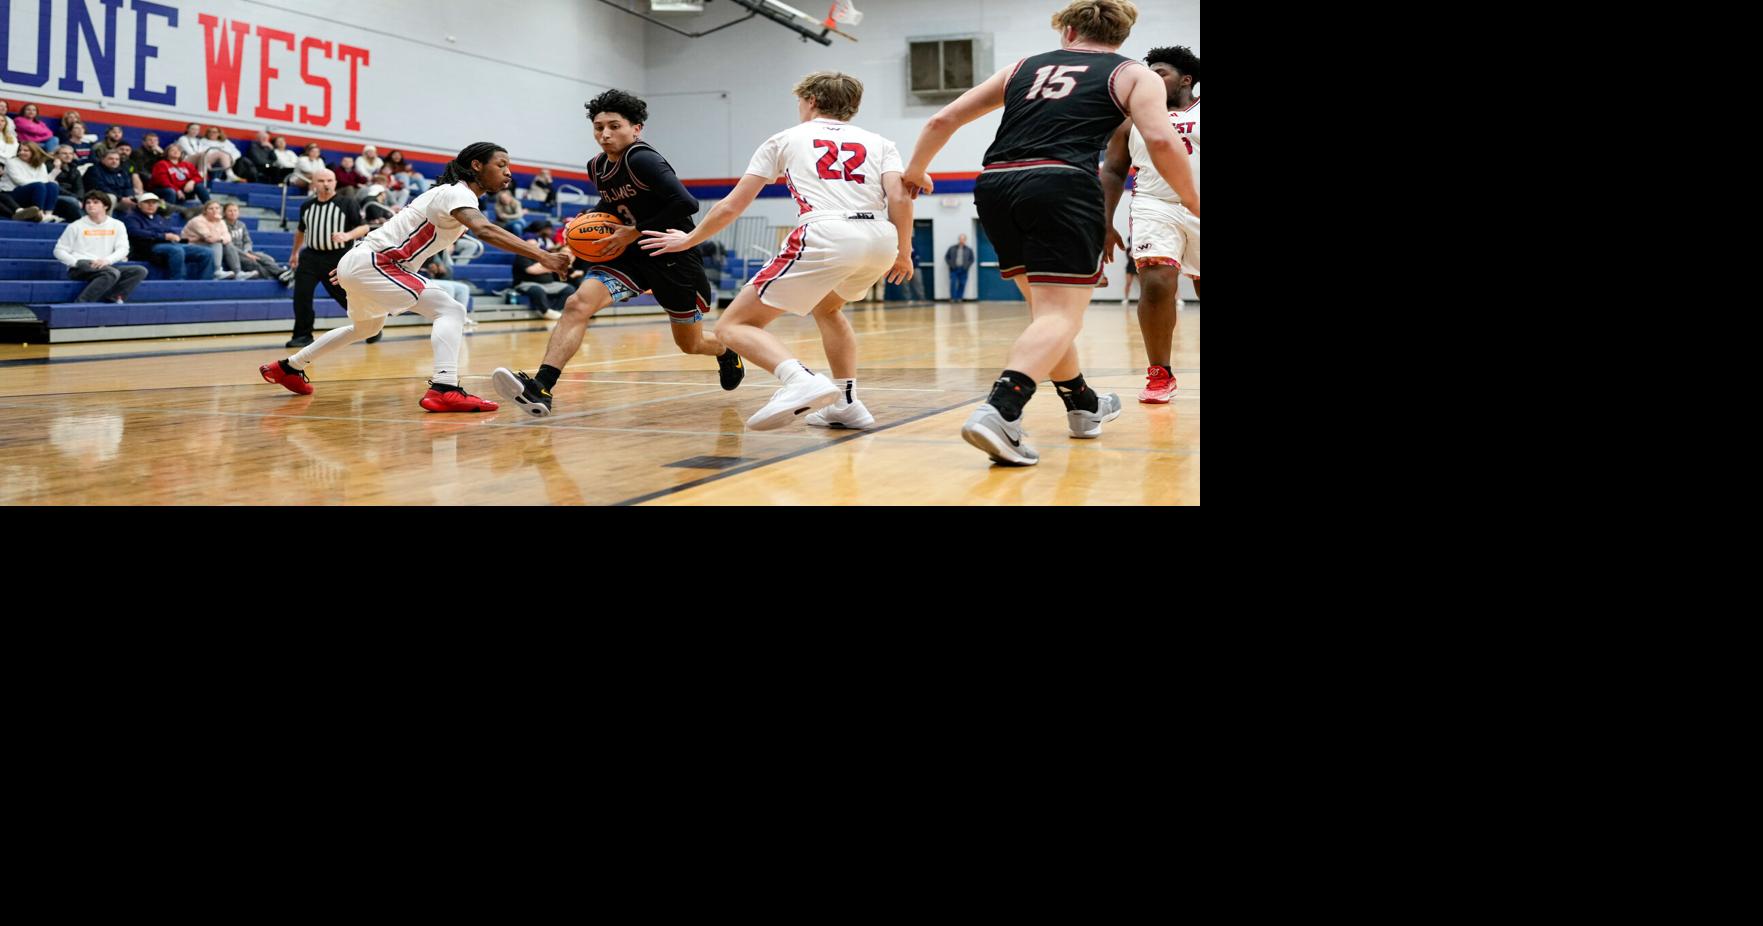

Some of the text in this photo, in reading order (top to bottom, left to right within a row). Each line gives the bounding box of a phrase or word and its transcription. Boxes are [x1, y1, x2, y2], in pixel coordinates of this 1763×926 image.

[198, 12, 370, 131] WEST
[1024, 64, 1090, 101] 15
[1172, 121, 1196, 134] ST
[813, 138, 867, 184] 22
[599, 184, 637, 203] TRJANS
